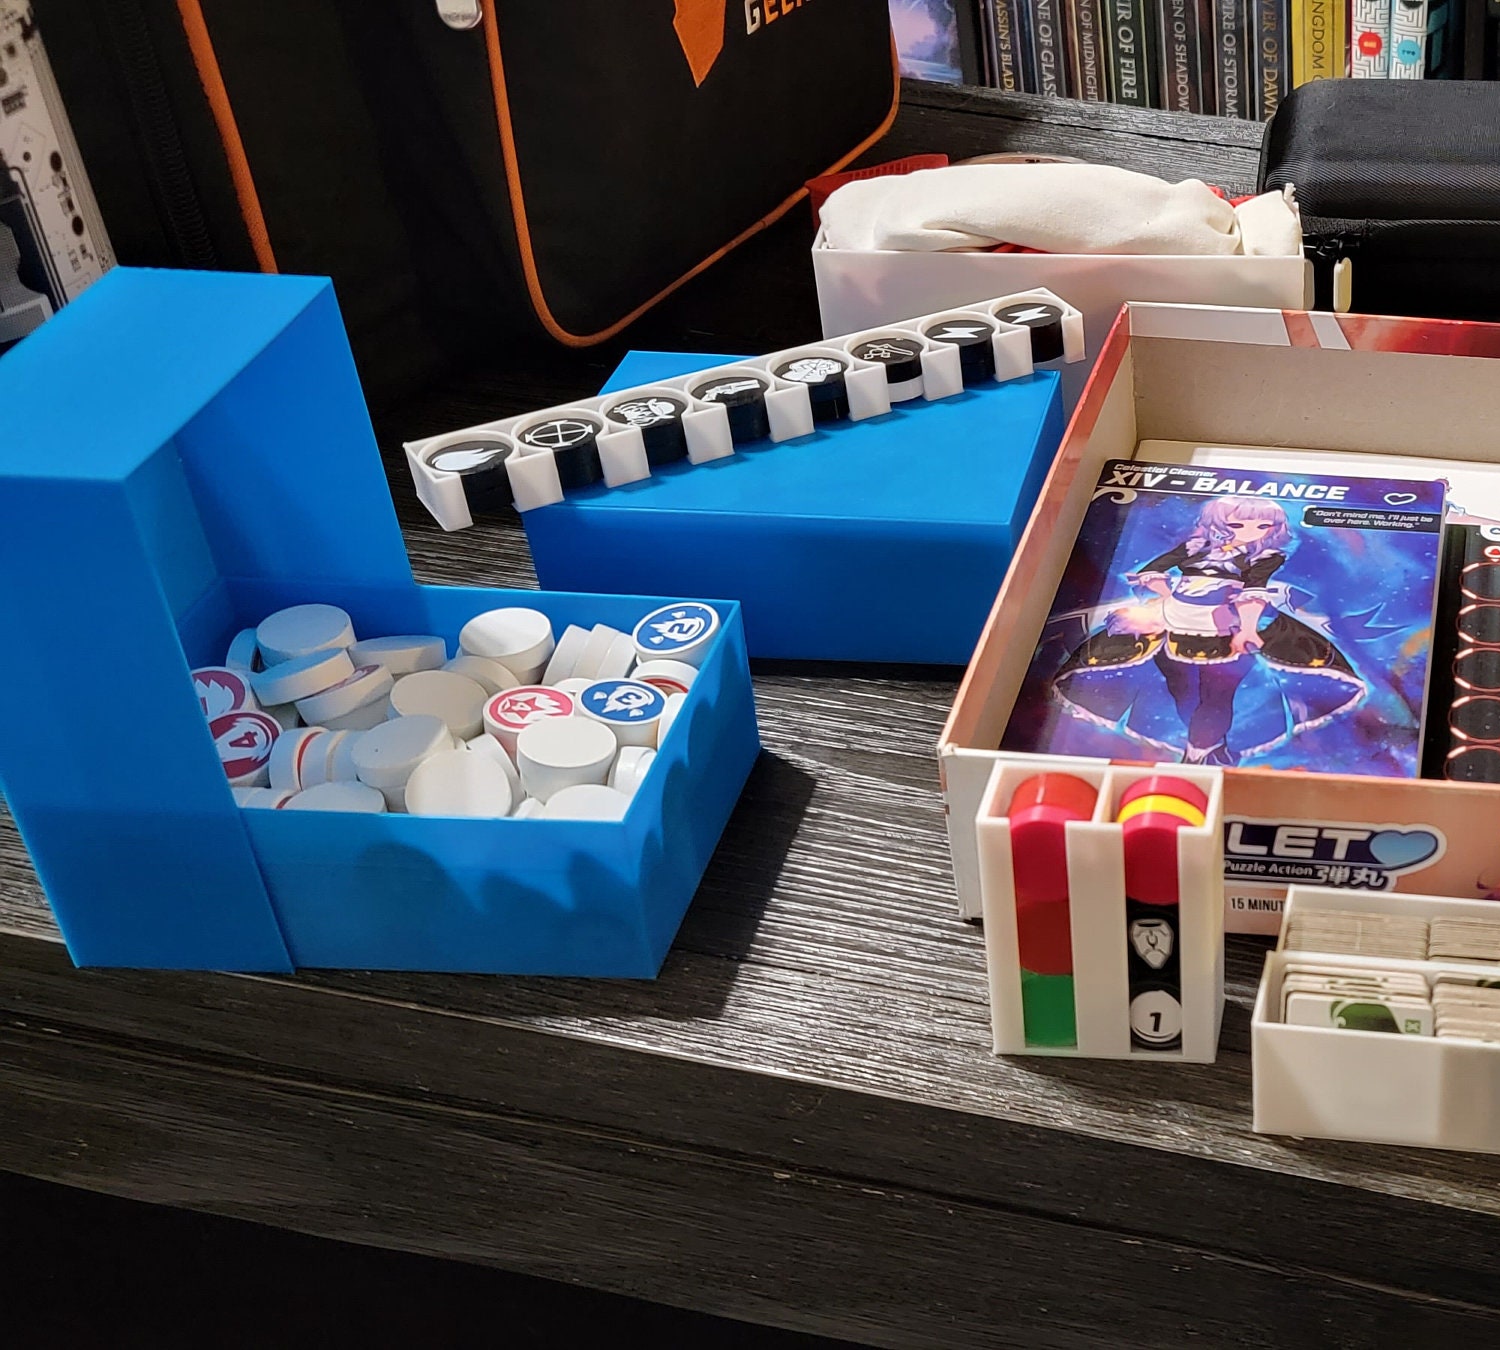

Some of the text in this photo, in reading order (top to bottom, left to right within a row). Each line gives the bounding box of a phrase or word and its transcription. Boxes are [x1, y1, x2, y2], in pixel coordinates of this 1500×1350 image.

[1081, 11, 1093, 29] OF
[1039, 24, 1053, 46] OF
[1118, 26, 1134, 54] OF
[1174, 22, 1186, 41] OF
[1223, 33, 1236, 55] OF
[1263, 38, 1277, 64] OF
[1120, 57, 1137, 99] FIRE
[1114, 463, 1217, 477] Celestial Cleaner
[1104, 470, 1167, 488] XIV
[1192, 477, 1350, 500] BALANCE
[1343, 511, 1367, 519] mind
[667, 621, 696, 635] 2
[229, 731, 259, 748] 4
[1269, 863, 1313, 877] Action
[1231, 897, 1245, 910] 15
[1149, 1011, 1162, 1033] 1
